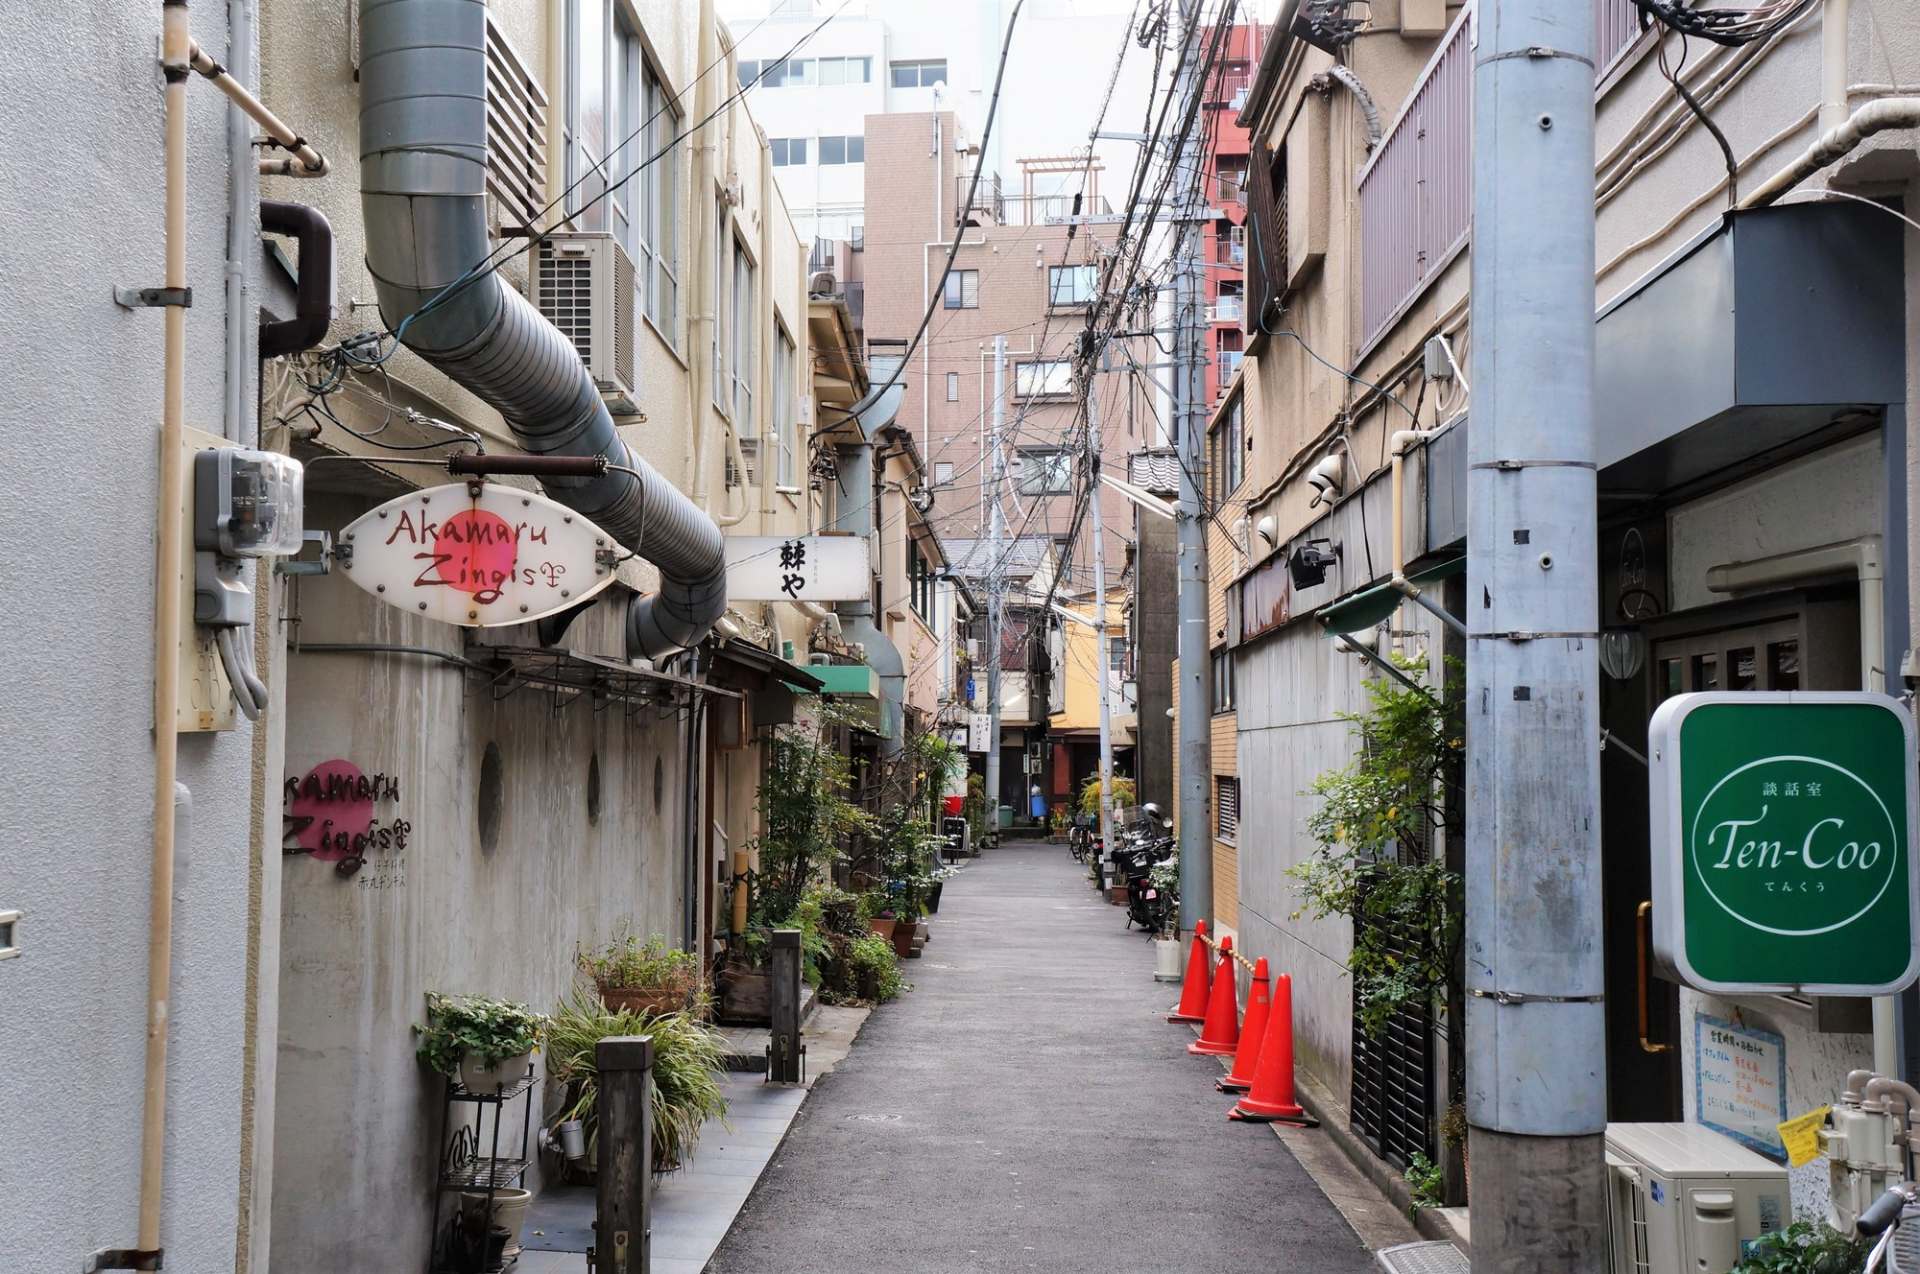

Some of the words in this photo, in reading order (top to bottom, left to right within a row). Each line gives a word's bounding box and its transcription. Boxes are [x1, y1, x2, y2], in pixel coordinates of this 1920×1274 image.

[386, 509, 547, 545] Akamaru
[413, 552, 537, 605] Zingis
[284, 772, 399, 805] kamaru
[1762, 782, 1822, 797] 談話室
[1707, 804, 1881, 870] Ten-Coo
[1765, 881, 1825, 892] てんくう
